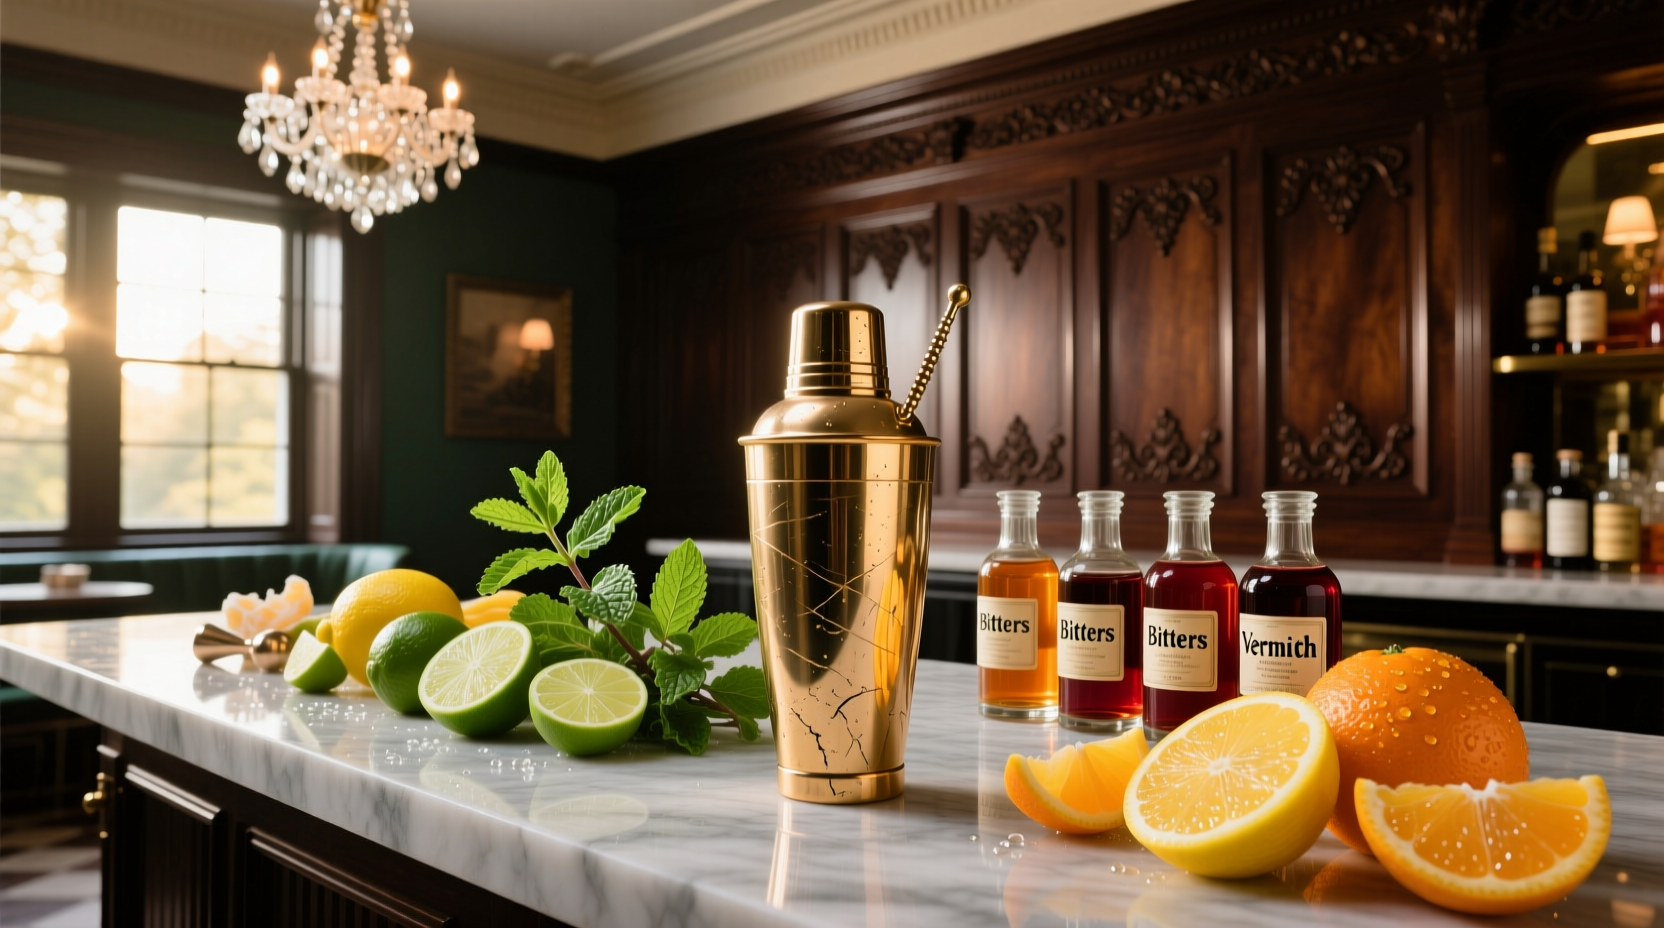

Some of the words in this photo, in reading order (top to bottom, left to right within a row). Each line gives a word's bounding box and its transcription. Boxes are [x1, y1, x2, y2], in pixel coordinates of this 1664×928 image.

[980, 613, 1030, 633] Bitters
[1061, 619, 1115, 642] Bitters
[1148, 625, 1208, 649] Bitters
